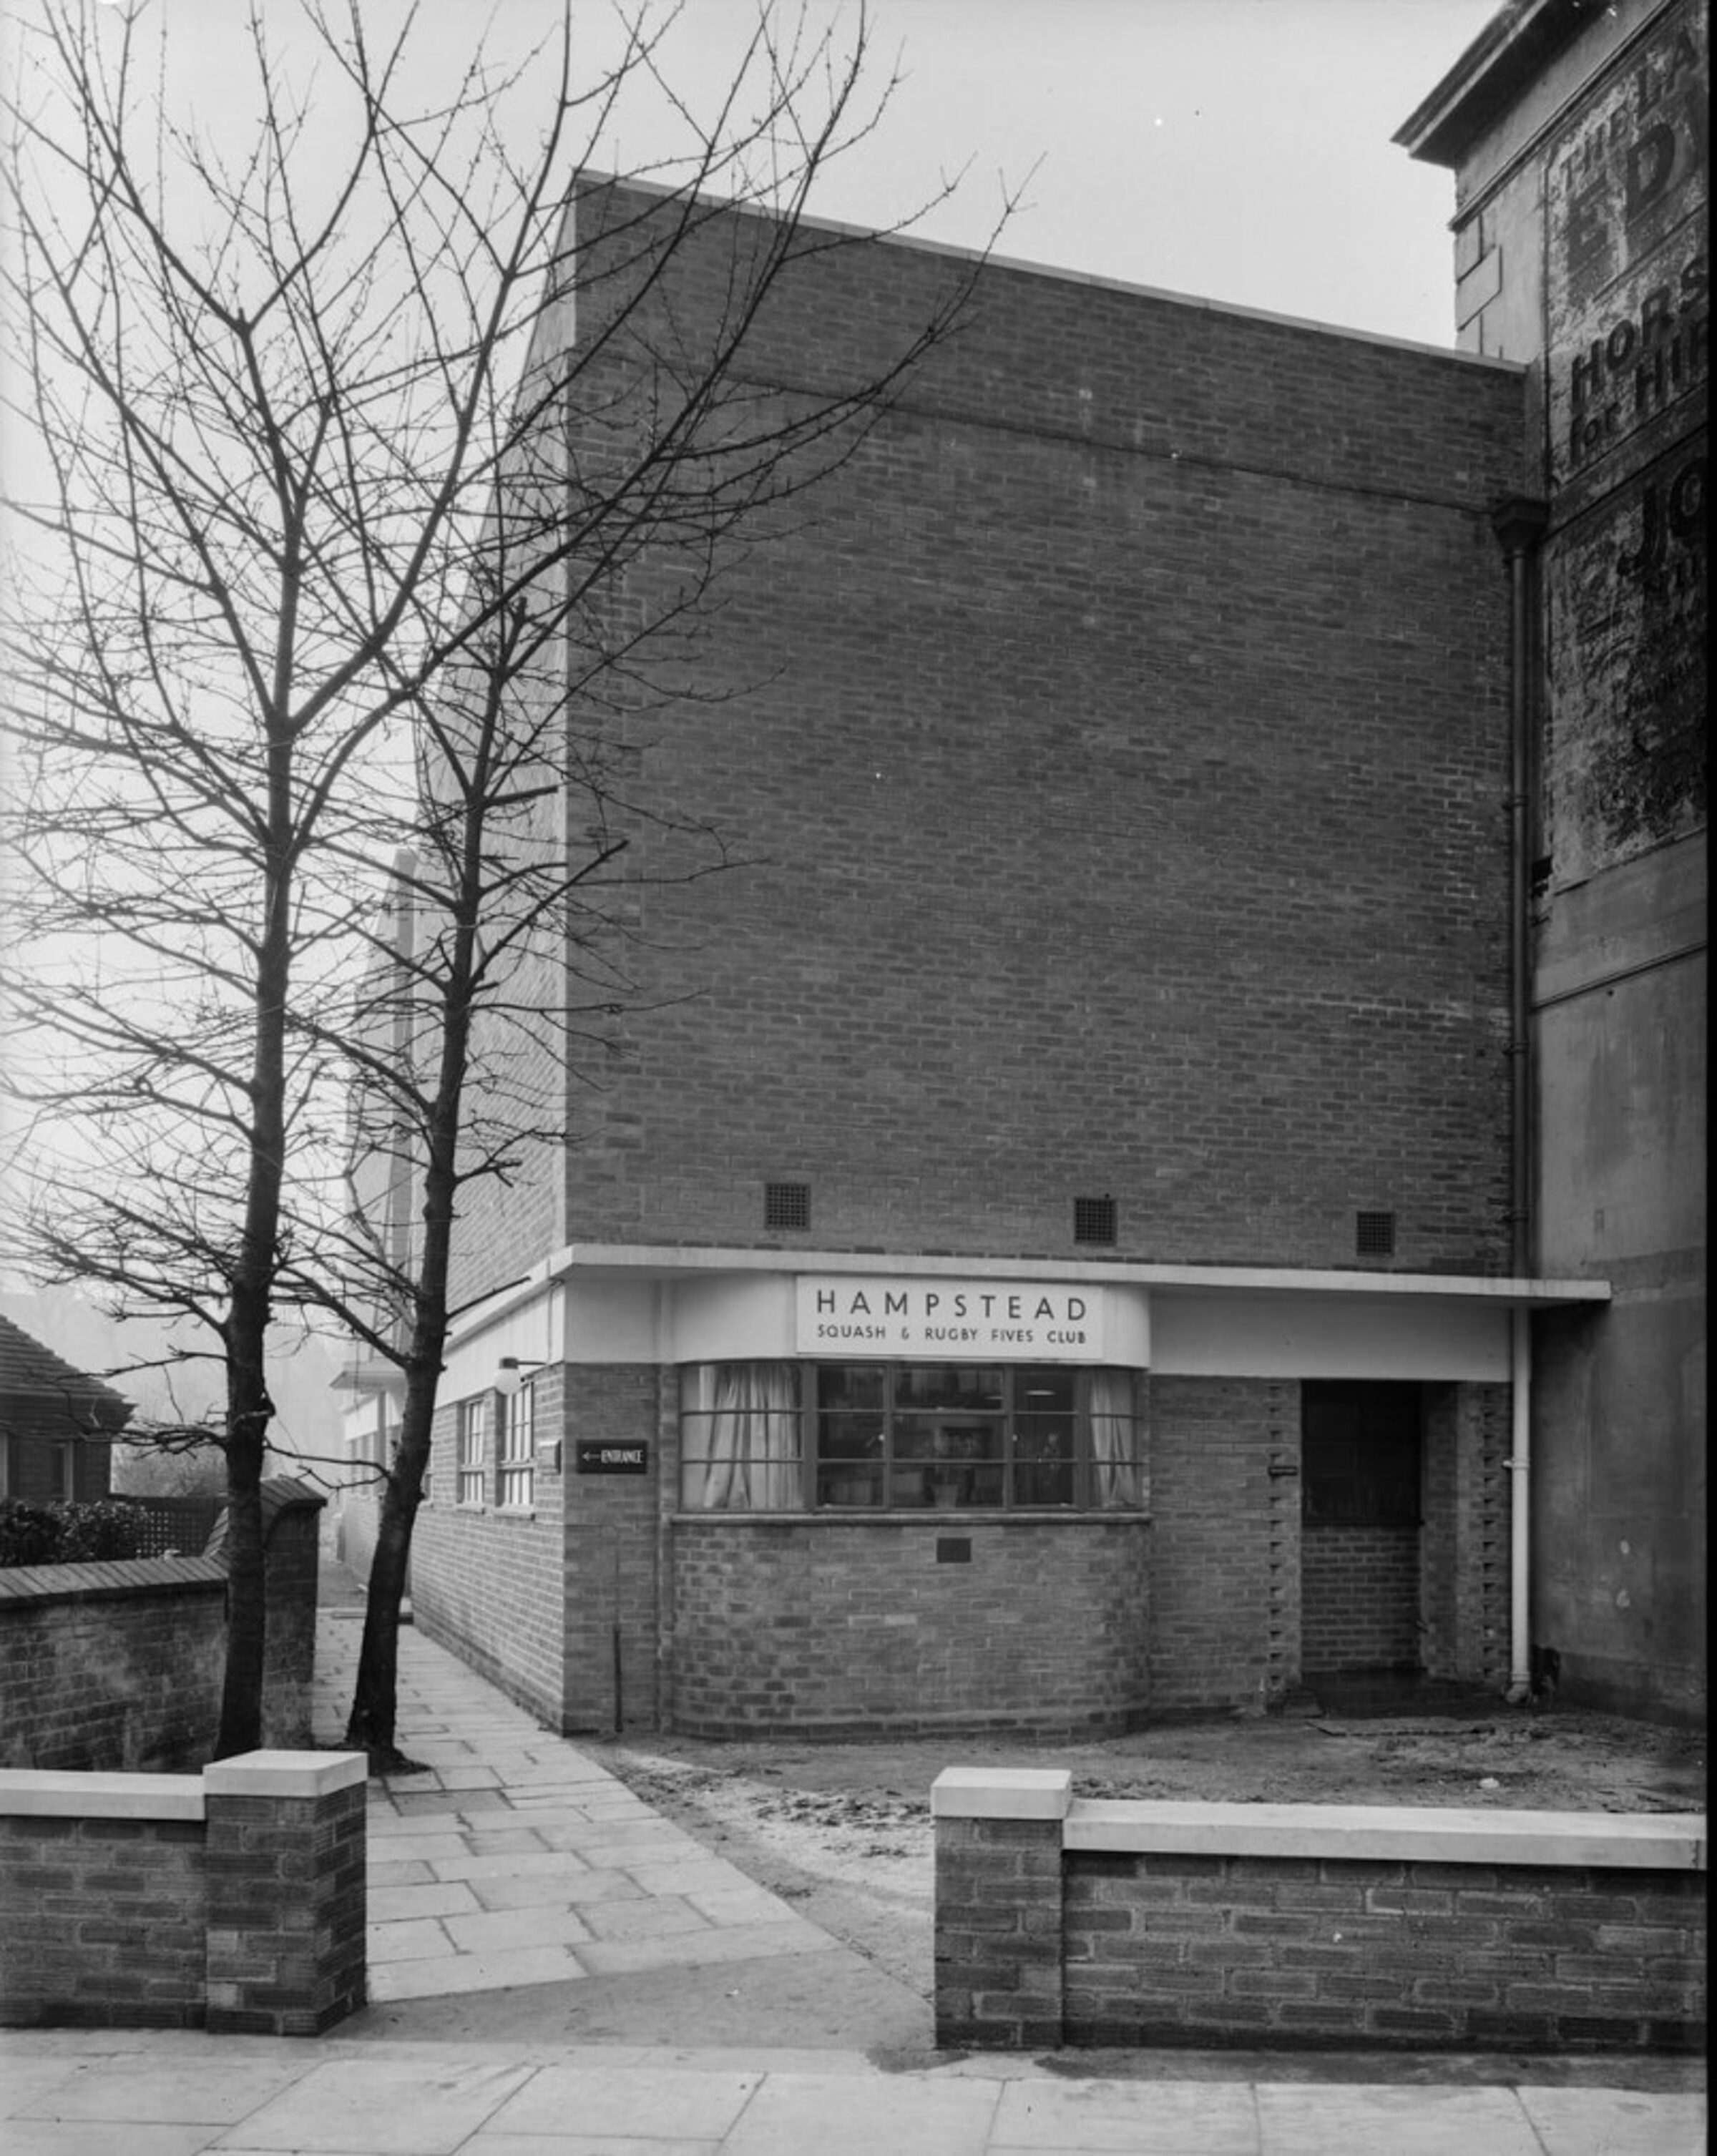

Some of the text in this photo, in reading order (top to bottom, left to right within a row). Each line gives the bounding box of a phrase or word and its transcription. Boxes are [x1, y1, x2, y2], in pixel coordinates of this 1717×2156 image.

[817, 1290, 1086, 1320] HAMPSTEAD
[818, 1324, 1086, 1344] SQUASH & RUGBY FIVES CLUB
[601, 1449, 643, 1464] ENTRANCE
